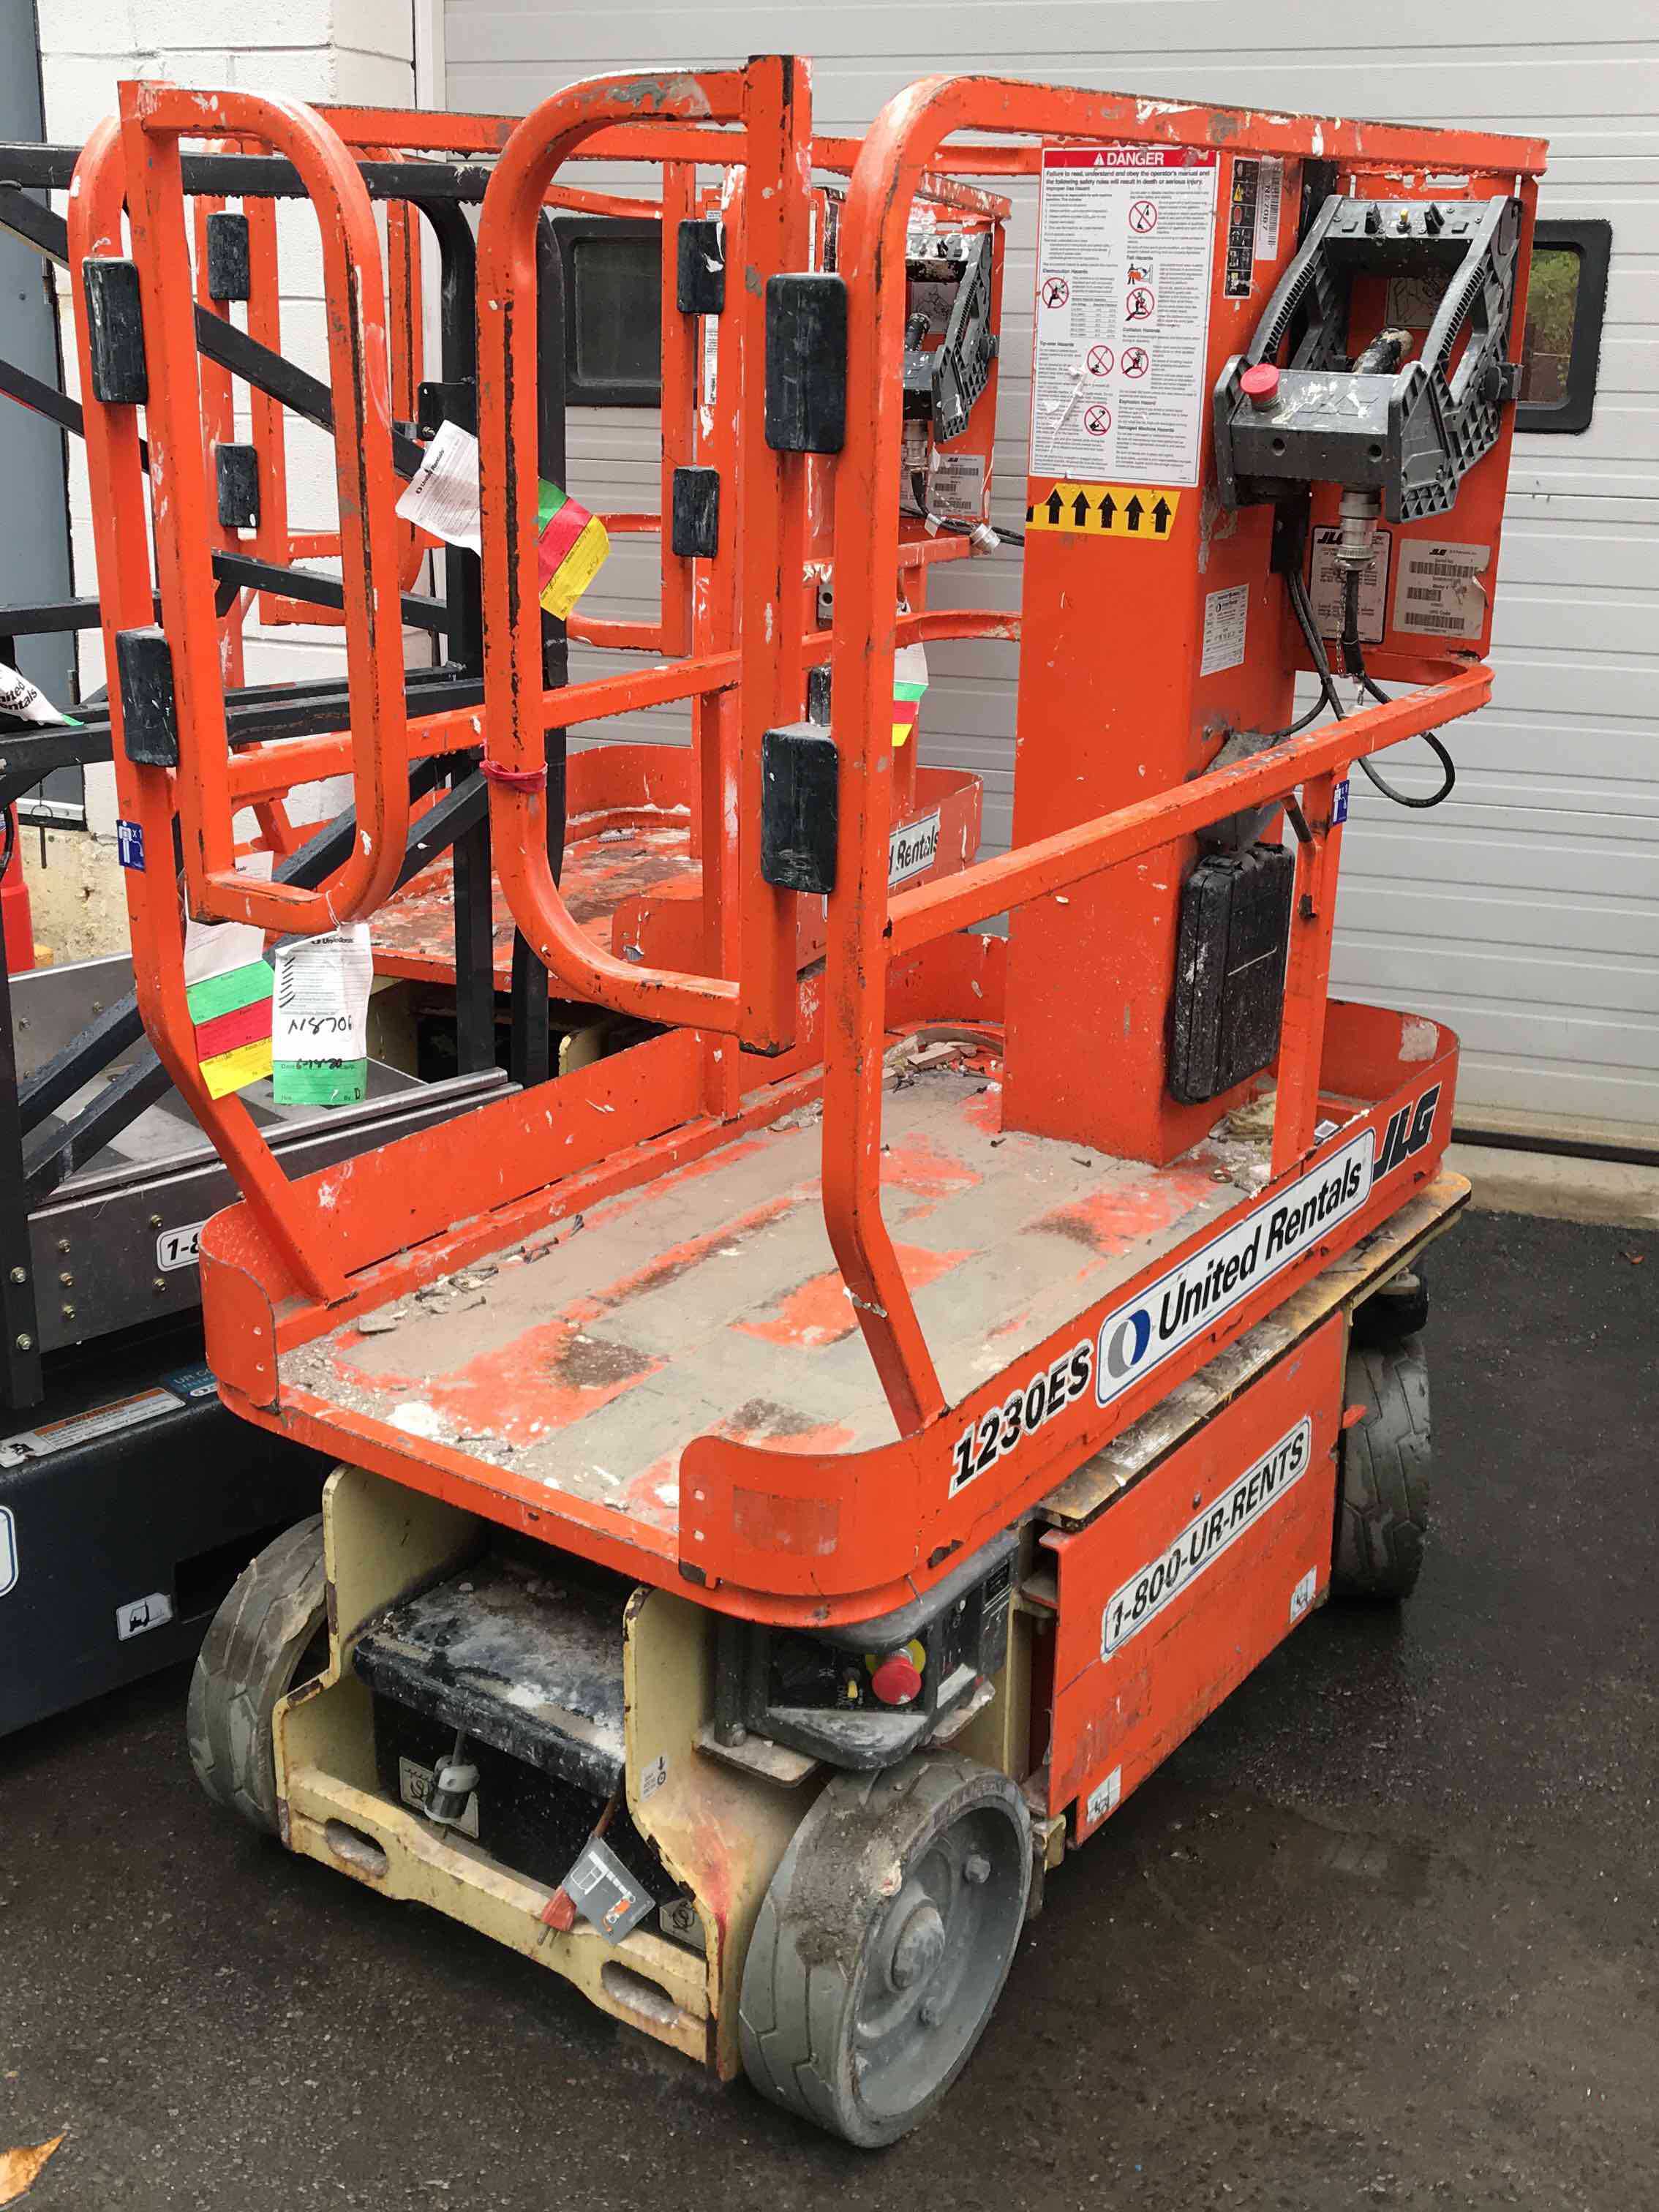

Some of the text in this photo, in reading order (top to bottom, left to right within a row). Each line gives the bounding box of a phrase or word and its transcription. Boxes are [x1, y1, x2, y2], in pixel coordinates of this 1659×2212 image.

[1107, 151, 1165, 165] DANGER
[0, 689, 37, 710] entals
[1372, 1083, 1441, 1183] JLG
[1159, 1157, 1363, 1340] United Rentals
[955, 1344, 1091, 1488] 1230ES
[1112, 1432, 1305, 1639] 1-800-UR-RENTS
